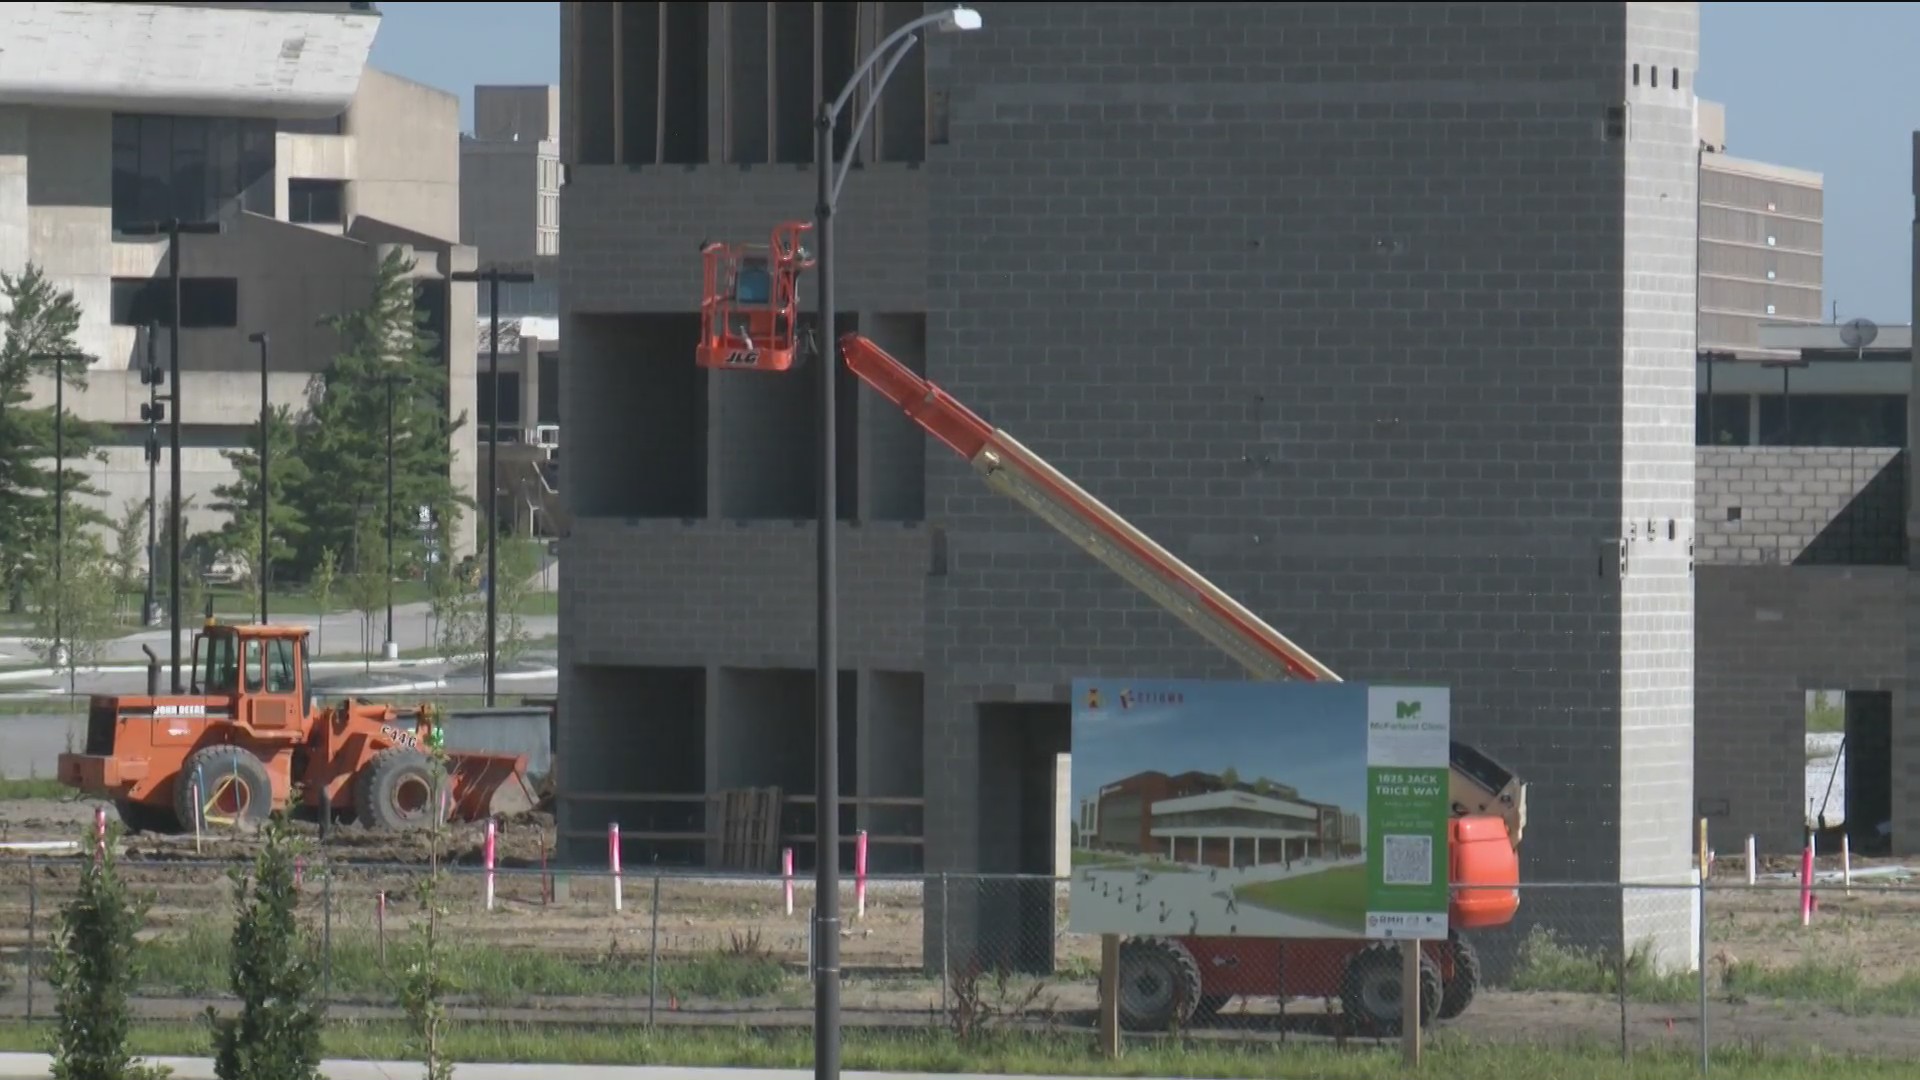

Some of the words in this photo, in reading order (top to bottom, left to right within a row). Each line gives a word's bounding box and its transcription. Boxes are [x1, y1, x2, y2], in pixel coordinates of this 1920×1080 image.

[725, 351, 758, 363] JLG
[152, 705, 177, 716] JOHN
[178, 705, 206, 716] DEERE
[1407, 774, 1438, 784] JACK
[1376, 785, 1410, 796] TRICE
[1413, 785, 1441, 796] WAY
